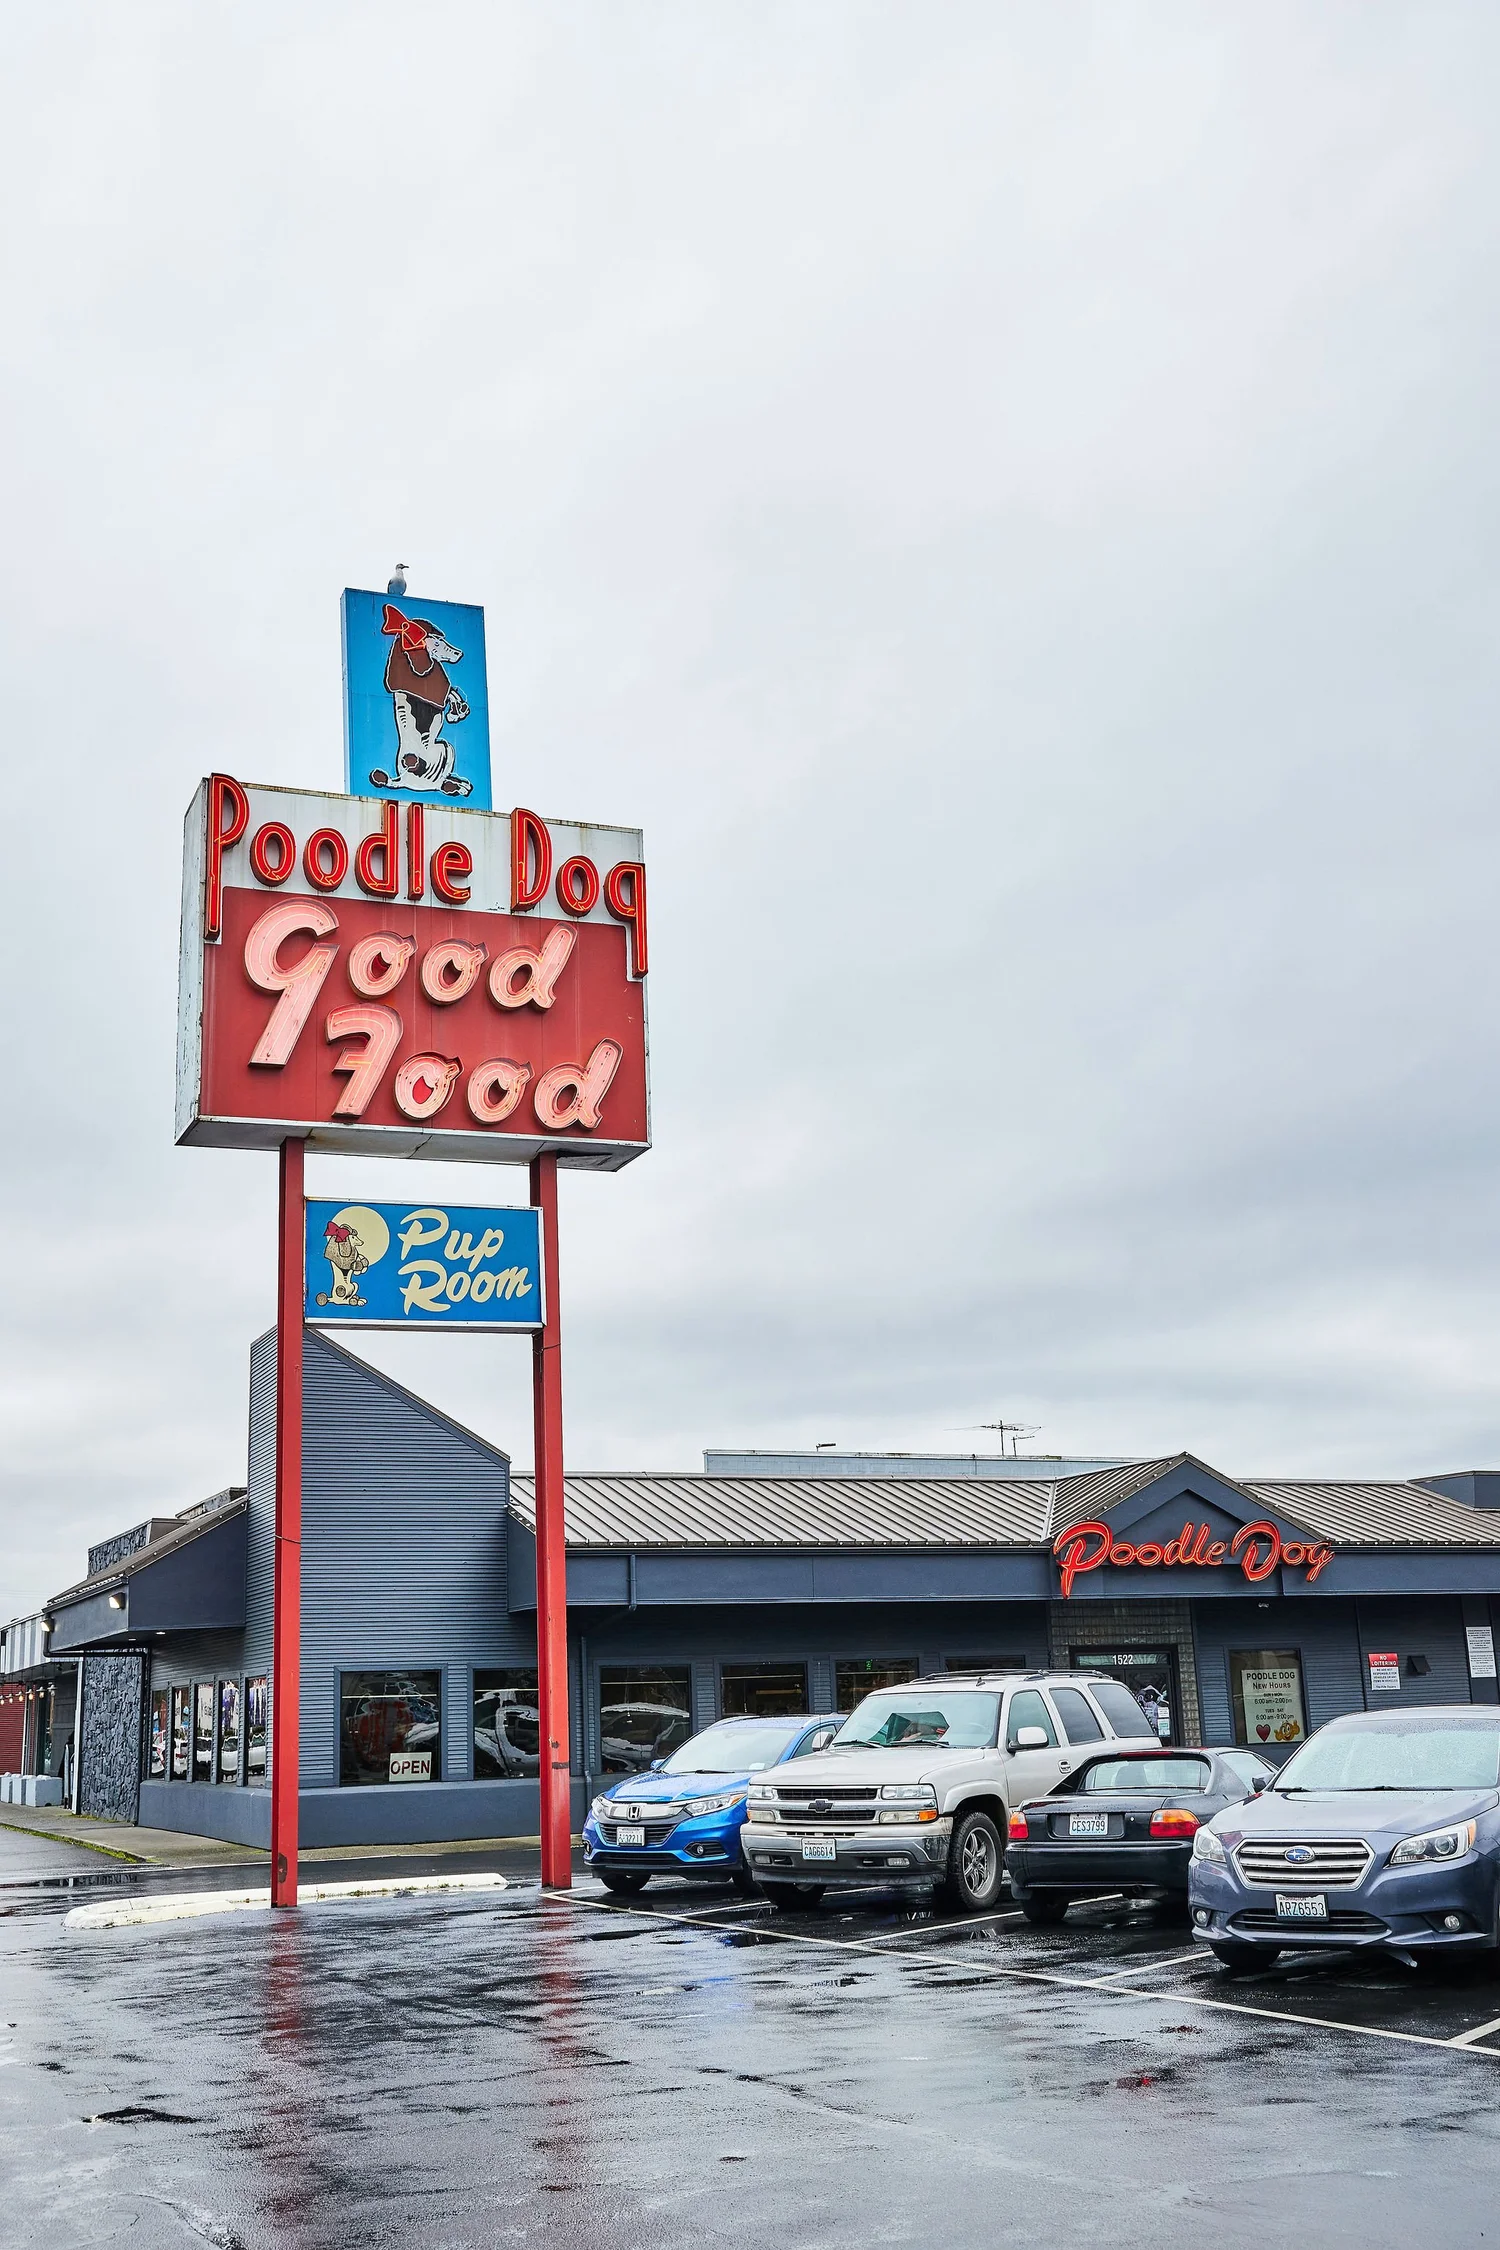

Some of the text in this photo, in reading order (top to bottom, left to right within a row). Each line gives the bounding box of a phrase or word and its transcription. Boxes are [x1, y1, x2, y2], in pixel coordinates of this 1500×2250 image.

[204, 772, 648, 978] Poodle Dog
[244, 897, 578, 1067] Good
[325, 1001, 623, 1130] Food
[398, 1208, 504, 1272] Pup
[398, 1259, 533, 1315] Room
[1053, 1519, 1336, 1600] Poodle Dog
[1112, 1654, 1134, 1665] 1522
[1246, 1672, 1277, 1680] POODLE
[390, 1760, 431, 1775] OPEN
[1071, 1820, 1106, 1832] CES3799
[1279, 1901, 1325, 1916] ARZ6553
